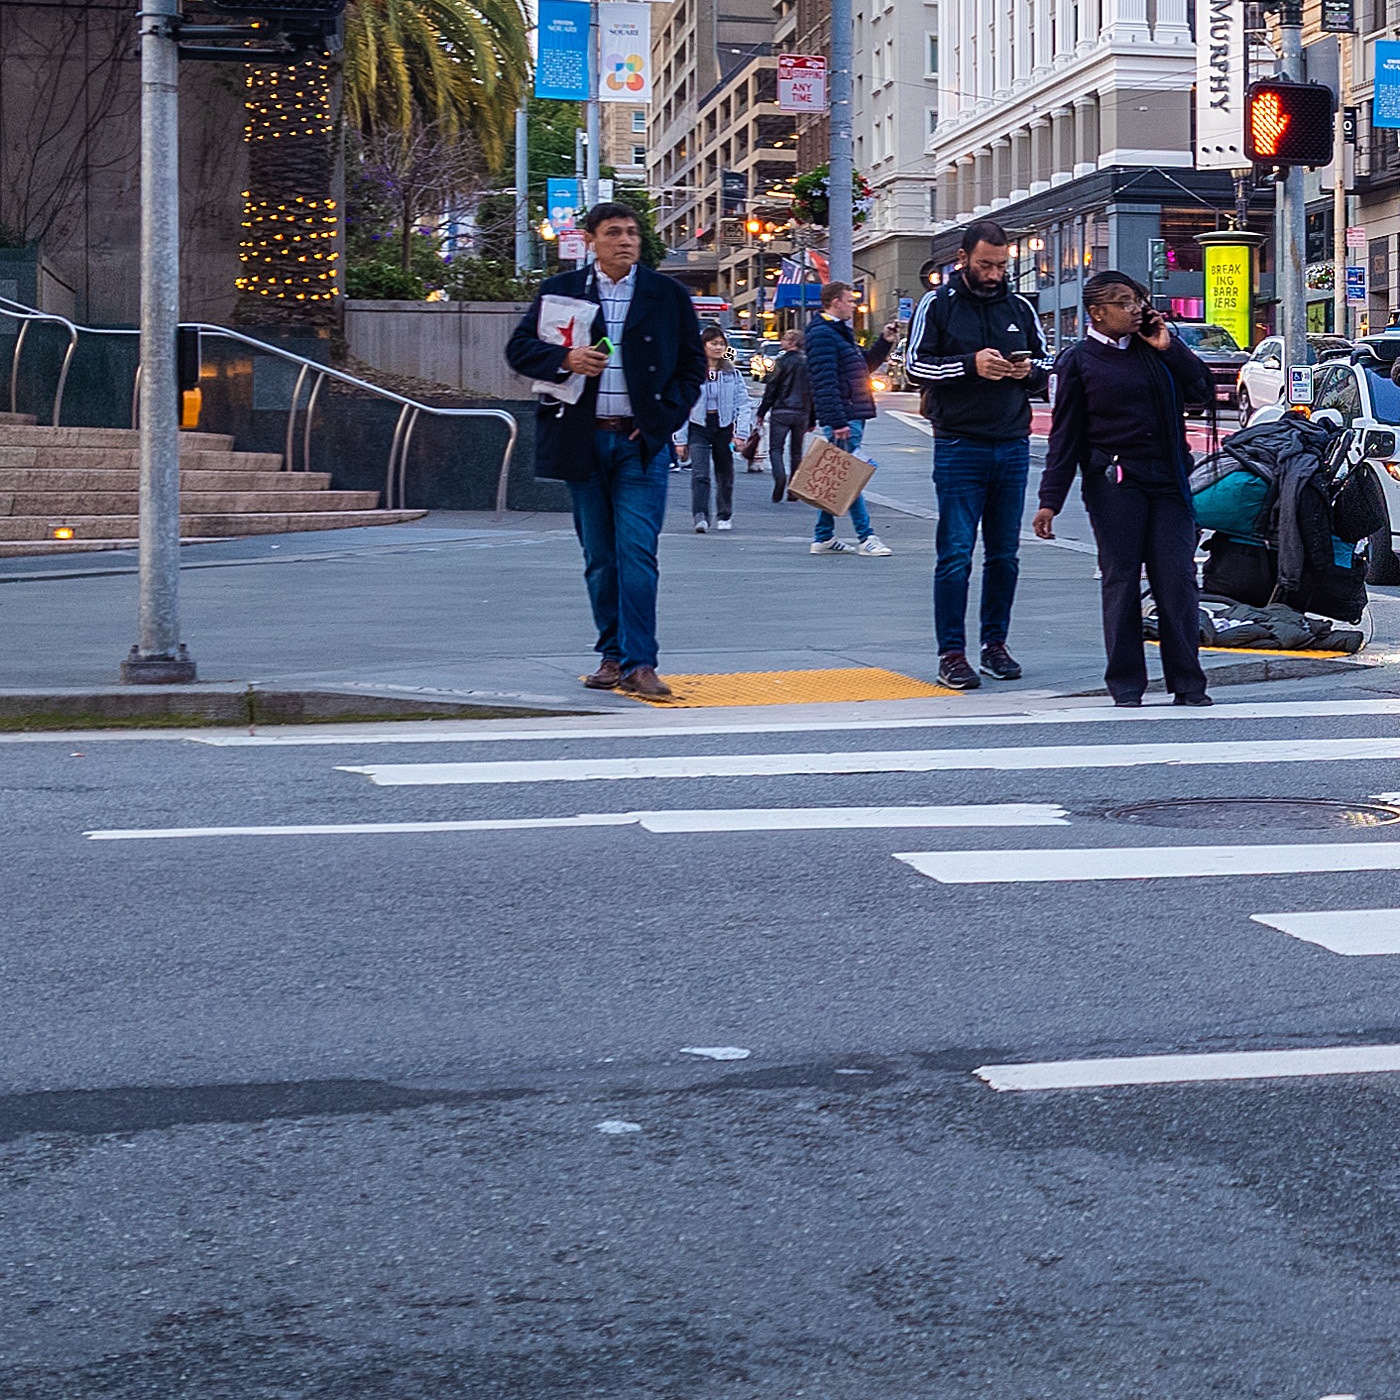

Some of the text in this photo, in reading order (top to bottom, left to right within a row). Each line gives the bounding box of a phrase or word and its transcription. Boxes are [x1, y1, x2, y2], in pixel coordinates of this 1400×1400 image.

[791, 83, 812, 91] ANY
[791, 93, 813, 102] TIME
[1211, 263, 1242, 275] BREAK
[1216, 276, 1235, 286] ING
[1213, 286, 1239, 297] BARR
[1214, 297, 1237, 309] IERS
[823, 448, 852, 470] Give
